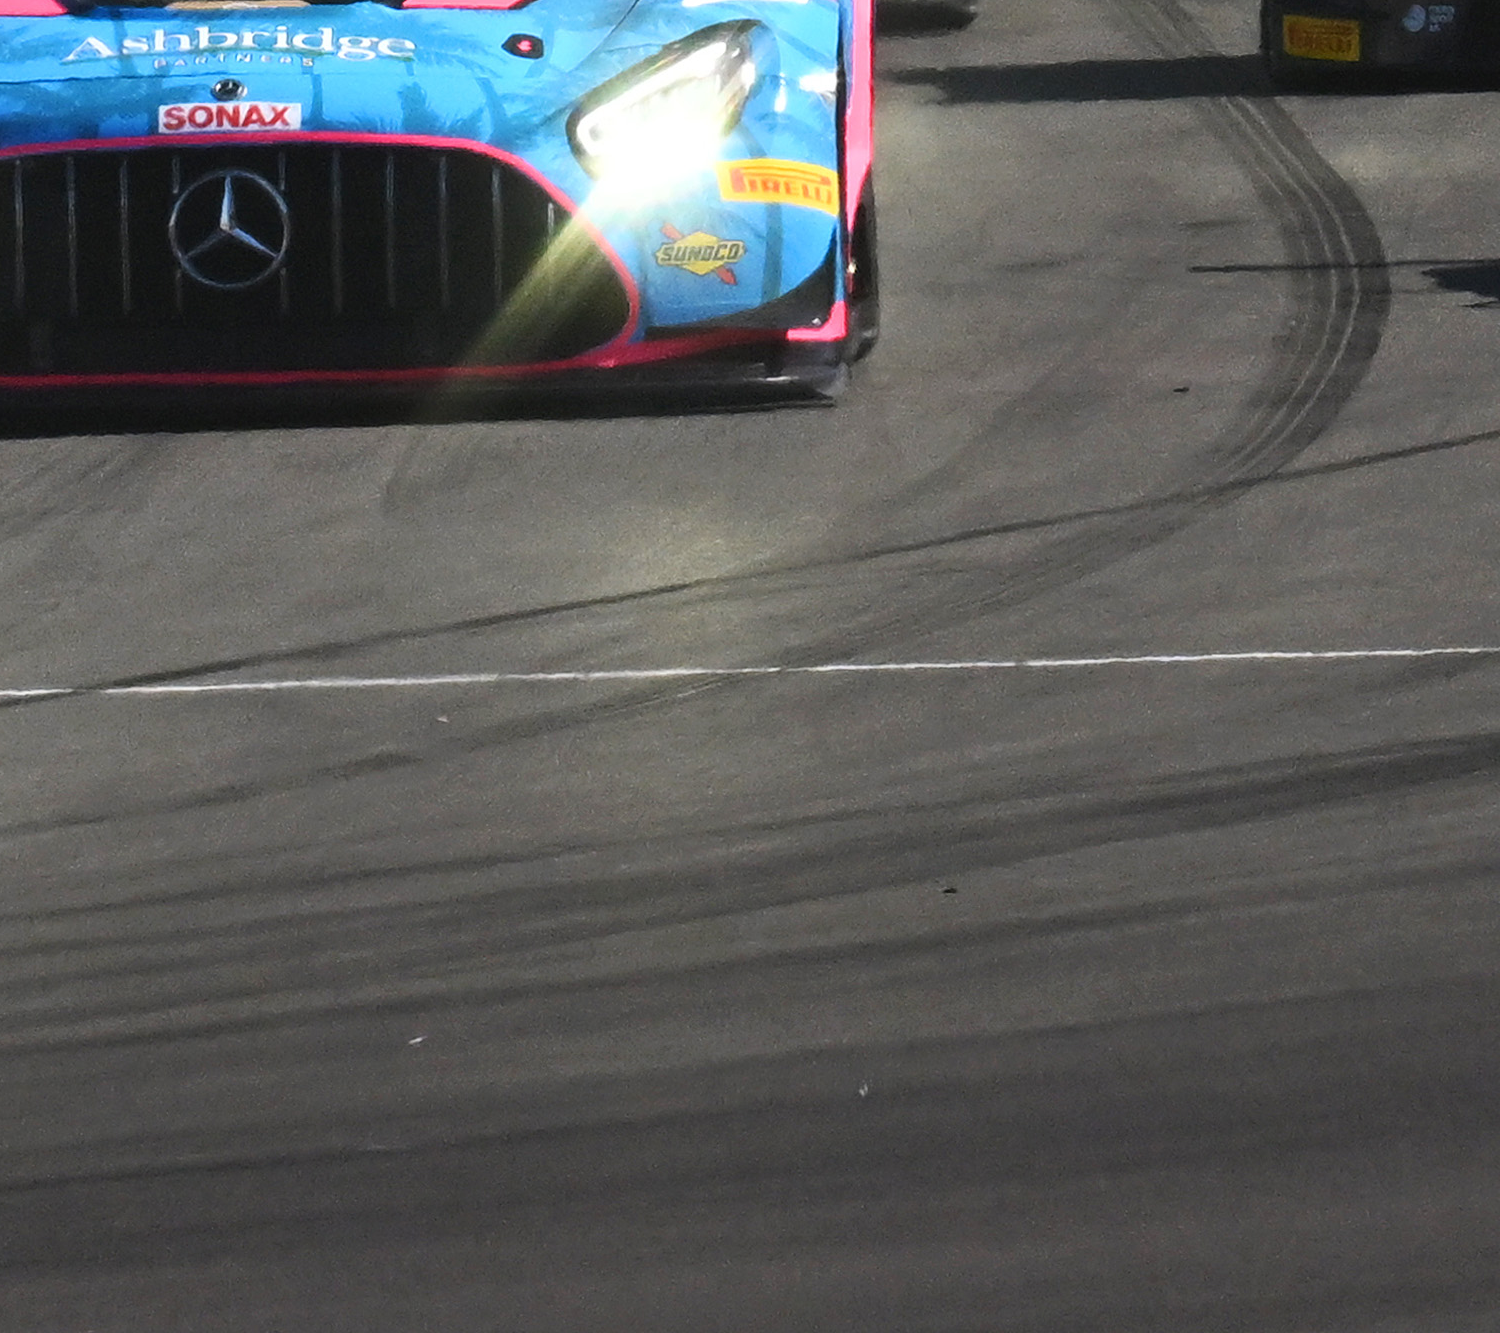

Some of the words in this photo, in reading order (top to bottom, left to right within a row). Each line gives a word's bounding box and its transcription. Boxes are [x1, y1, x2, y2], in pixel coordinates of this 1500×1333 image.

[61, 26, 416, 63] Ashbridge
[153, 52, 315, 69] PARTNERS
[162, 104, 291, 131] SONAX
[729, 167, 833, 206] PIRELLI
[659, 242, 742, 263] SUNOCO
